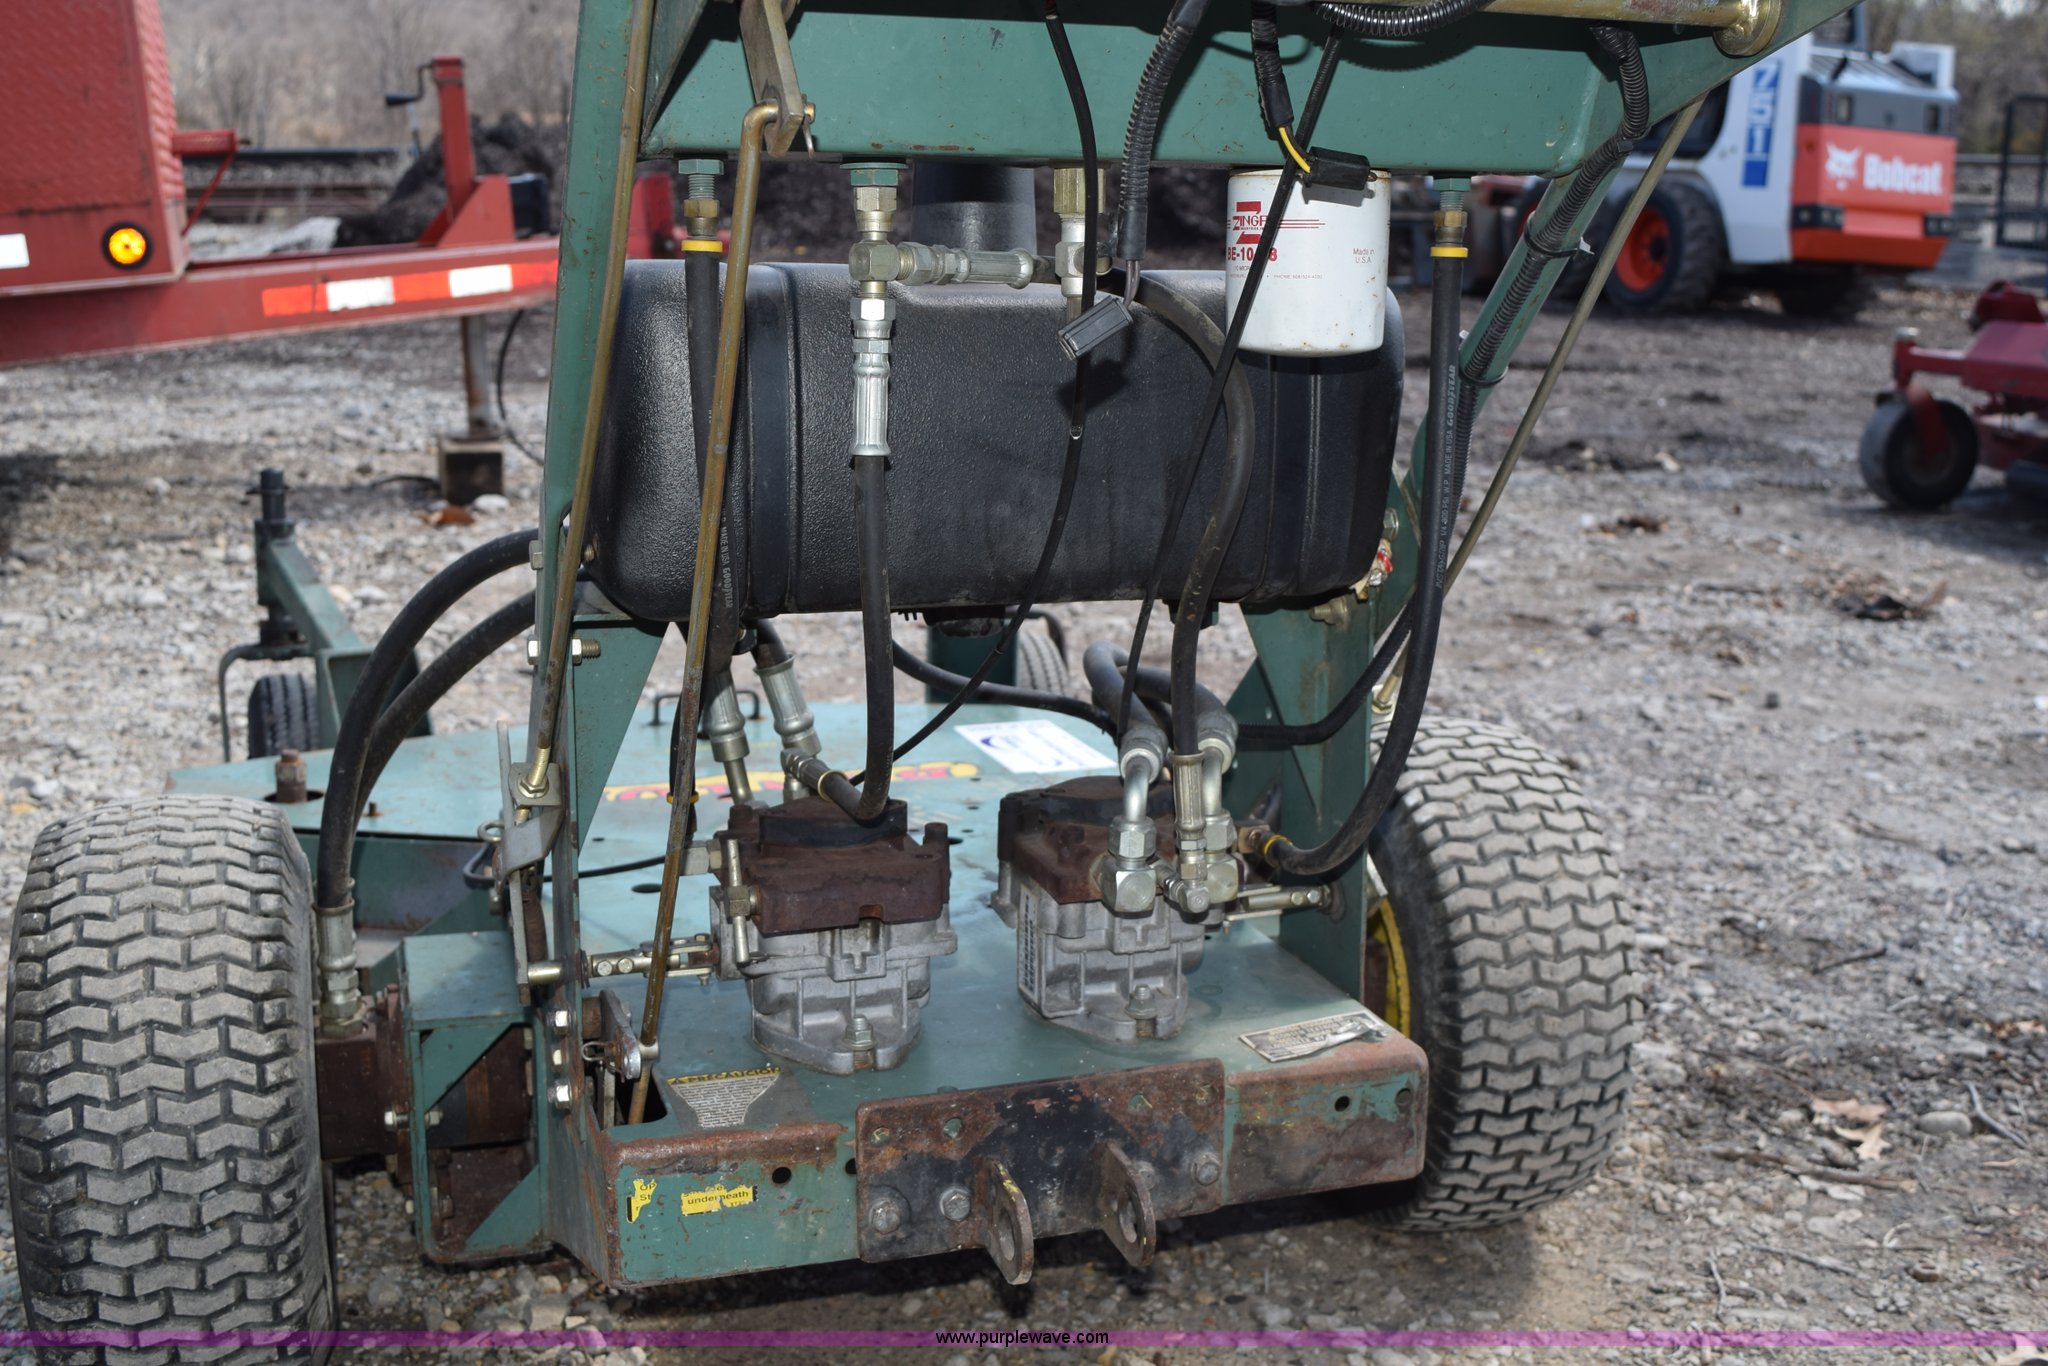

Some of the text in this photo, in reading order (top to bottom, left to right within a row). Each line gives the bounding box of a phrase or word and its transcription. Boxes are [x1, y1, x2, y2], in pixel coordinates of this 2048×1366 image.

[1863, 155, 1943, 195] Bobcat
[1447, 364, 1456, 426] GOODYEAR
[1444, 453, 1452, 475] MADE
[720, 526, 728, 545] MADE
[721, 552, 730, 565] USA
[722, 567, 733, 609] GOODYEAR
[687, 1190, 749, 1205] underneath
